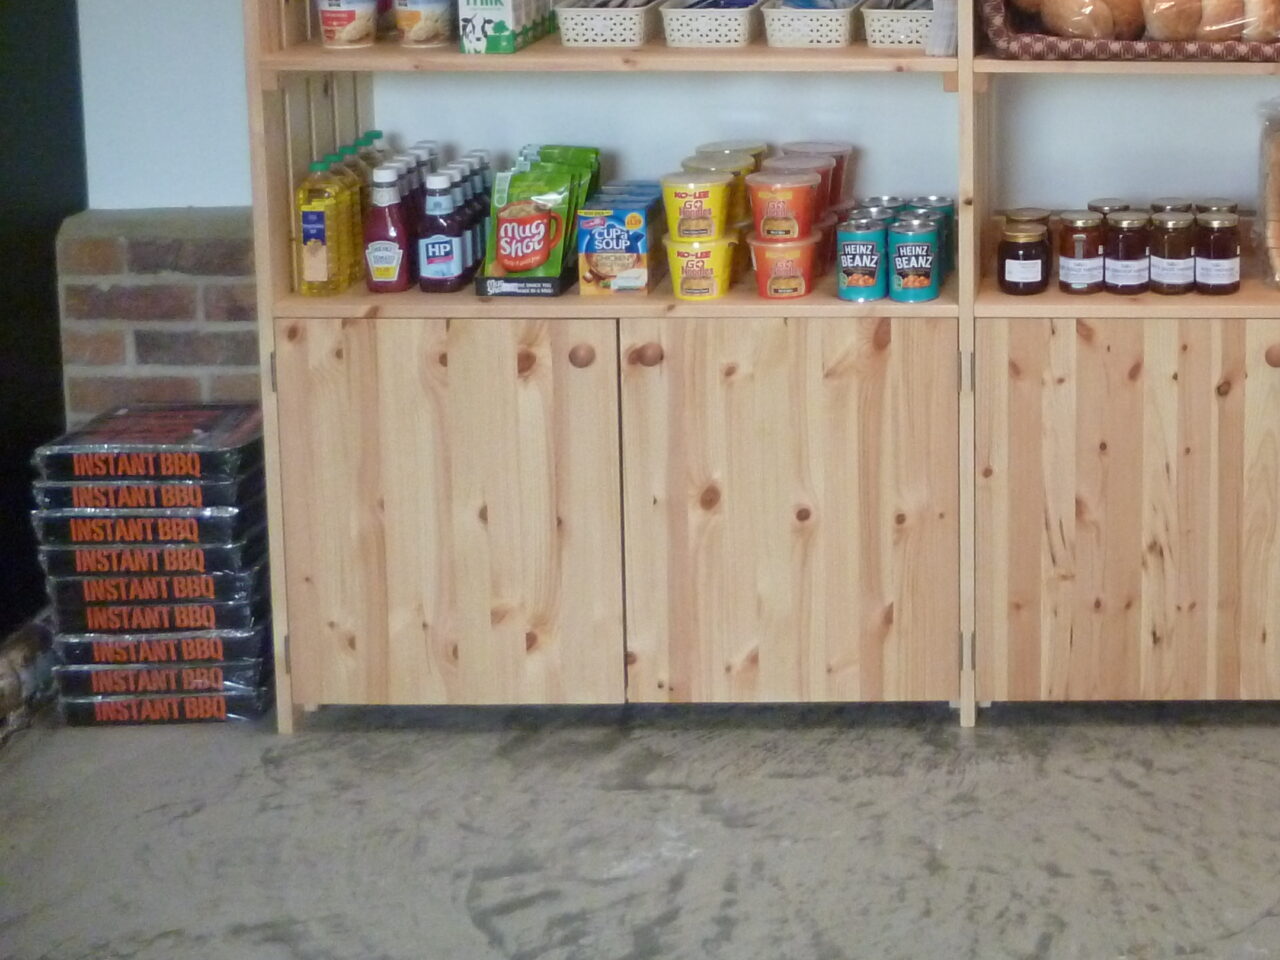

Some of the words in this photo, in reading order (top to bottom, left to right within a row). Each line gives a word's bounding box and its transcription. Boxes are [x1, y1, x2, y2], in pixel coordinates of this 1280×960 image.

[674, 190, 710, 199] KO-LEE
[499, 219, 546, 240] Mug
[428, 243, 451, 256] HP
[499, 235, 544, 258] Shot
[594, 239, 631, 250] SOUP
[676, 250, 712, 259] KO-LEE
[844, 244, 872, 254] HEINZ
[899, 246, 927, 256] HEINZ
[840, 255, 878, 267] BEANZ
[894, 256, 932, 268] BEANZ
[73, 452, 157, 476] INSTANT
[160, 452, 202, 476] BBQ
[72, 486, 156, 507] INSTANT
[161, 485, 203, 507] BBQ
[70, 518, 153, 542] INSTANT
[158, 518, 199, 542] BBQ
[76, 548, 161, 572] INSTANT
[164, 548, 205, 573] BBQ
[83, 577, 170, 602] INSTANT
[172, 575, 215, 599] BBQ
[86, 605, 170, 630] INSTANT
[174, 604, 216, 628] BBQ
[93, 639, 177, 662] INSTANT
[181, 638, 224, 661] BBQ
[91, 669, 177, 693] INSTANT
[182, 667, 224, 690] BBQ
[95, 698, 181, 722] INSTANT
[184, 696, 227, 720] BBQ
